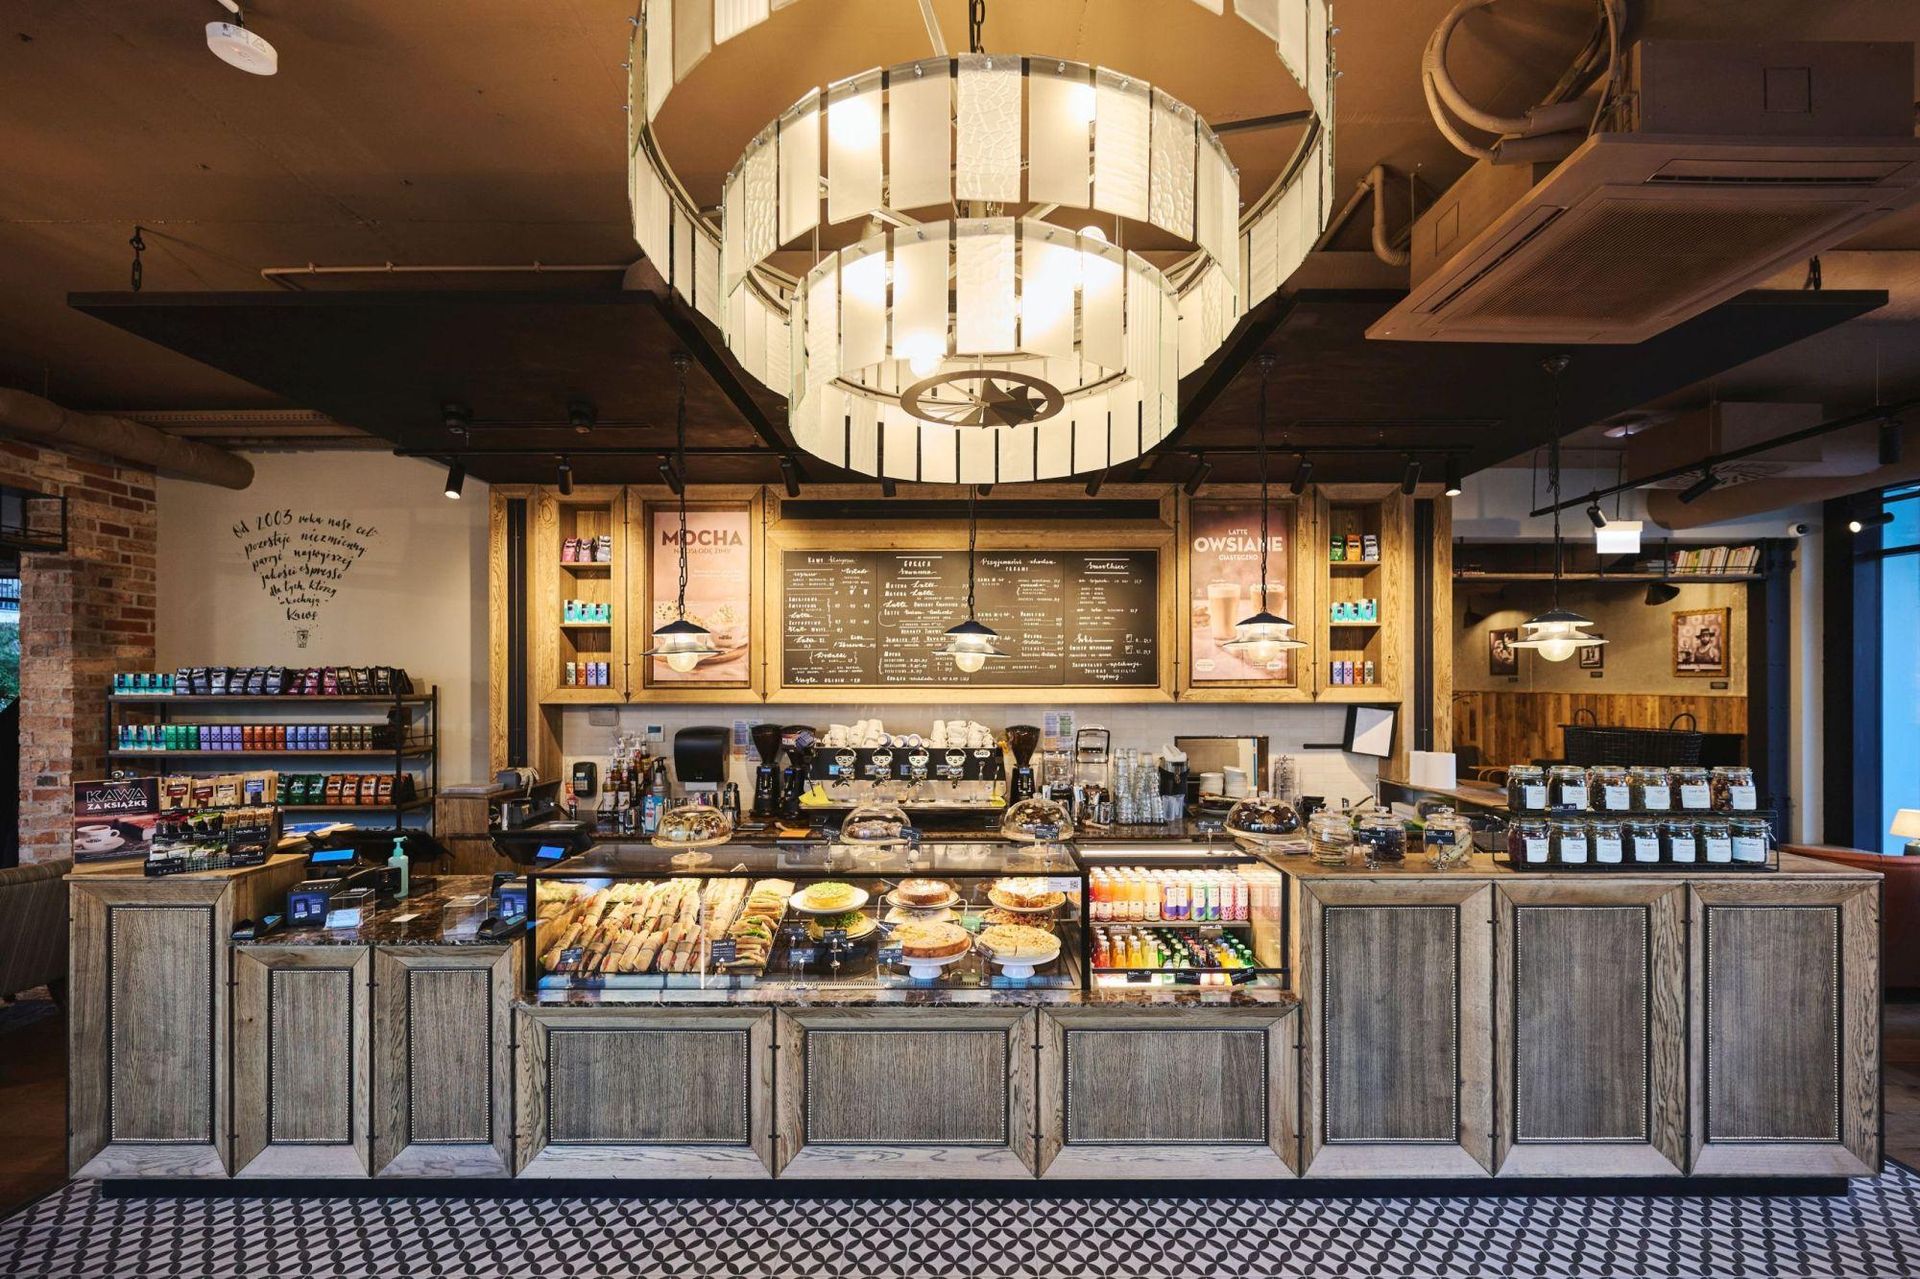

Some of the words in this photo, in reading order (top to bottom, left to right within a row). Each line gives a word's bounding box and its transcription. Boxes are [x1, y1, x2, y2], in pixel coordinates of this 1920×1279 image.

[232, 520, 250, 539] Od
[662, 529, 744, 546] MOCHA
[1193, 536, 1284, 553] OWSIANE
[86, 787, 149, 804] KAWA
[86, 803, 102, 811] ZA
[103, 800, 148, 809] KSIĄŻKĘ
